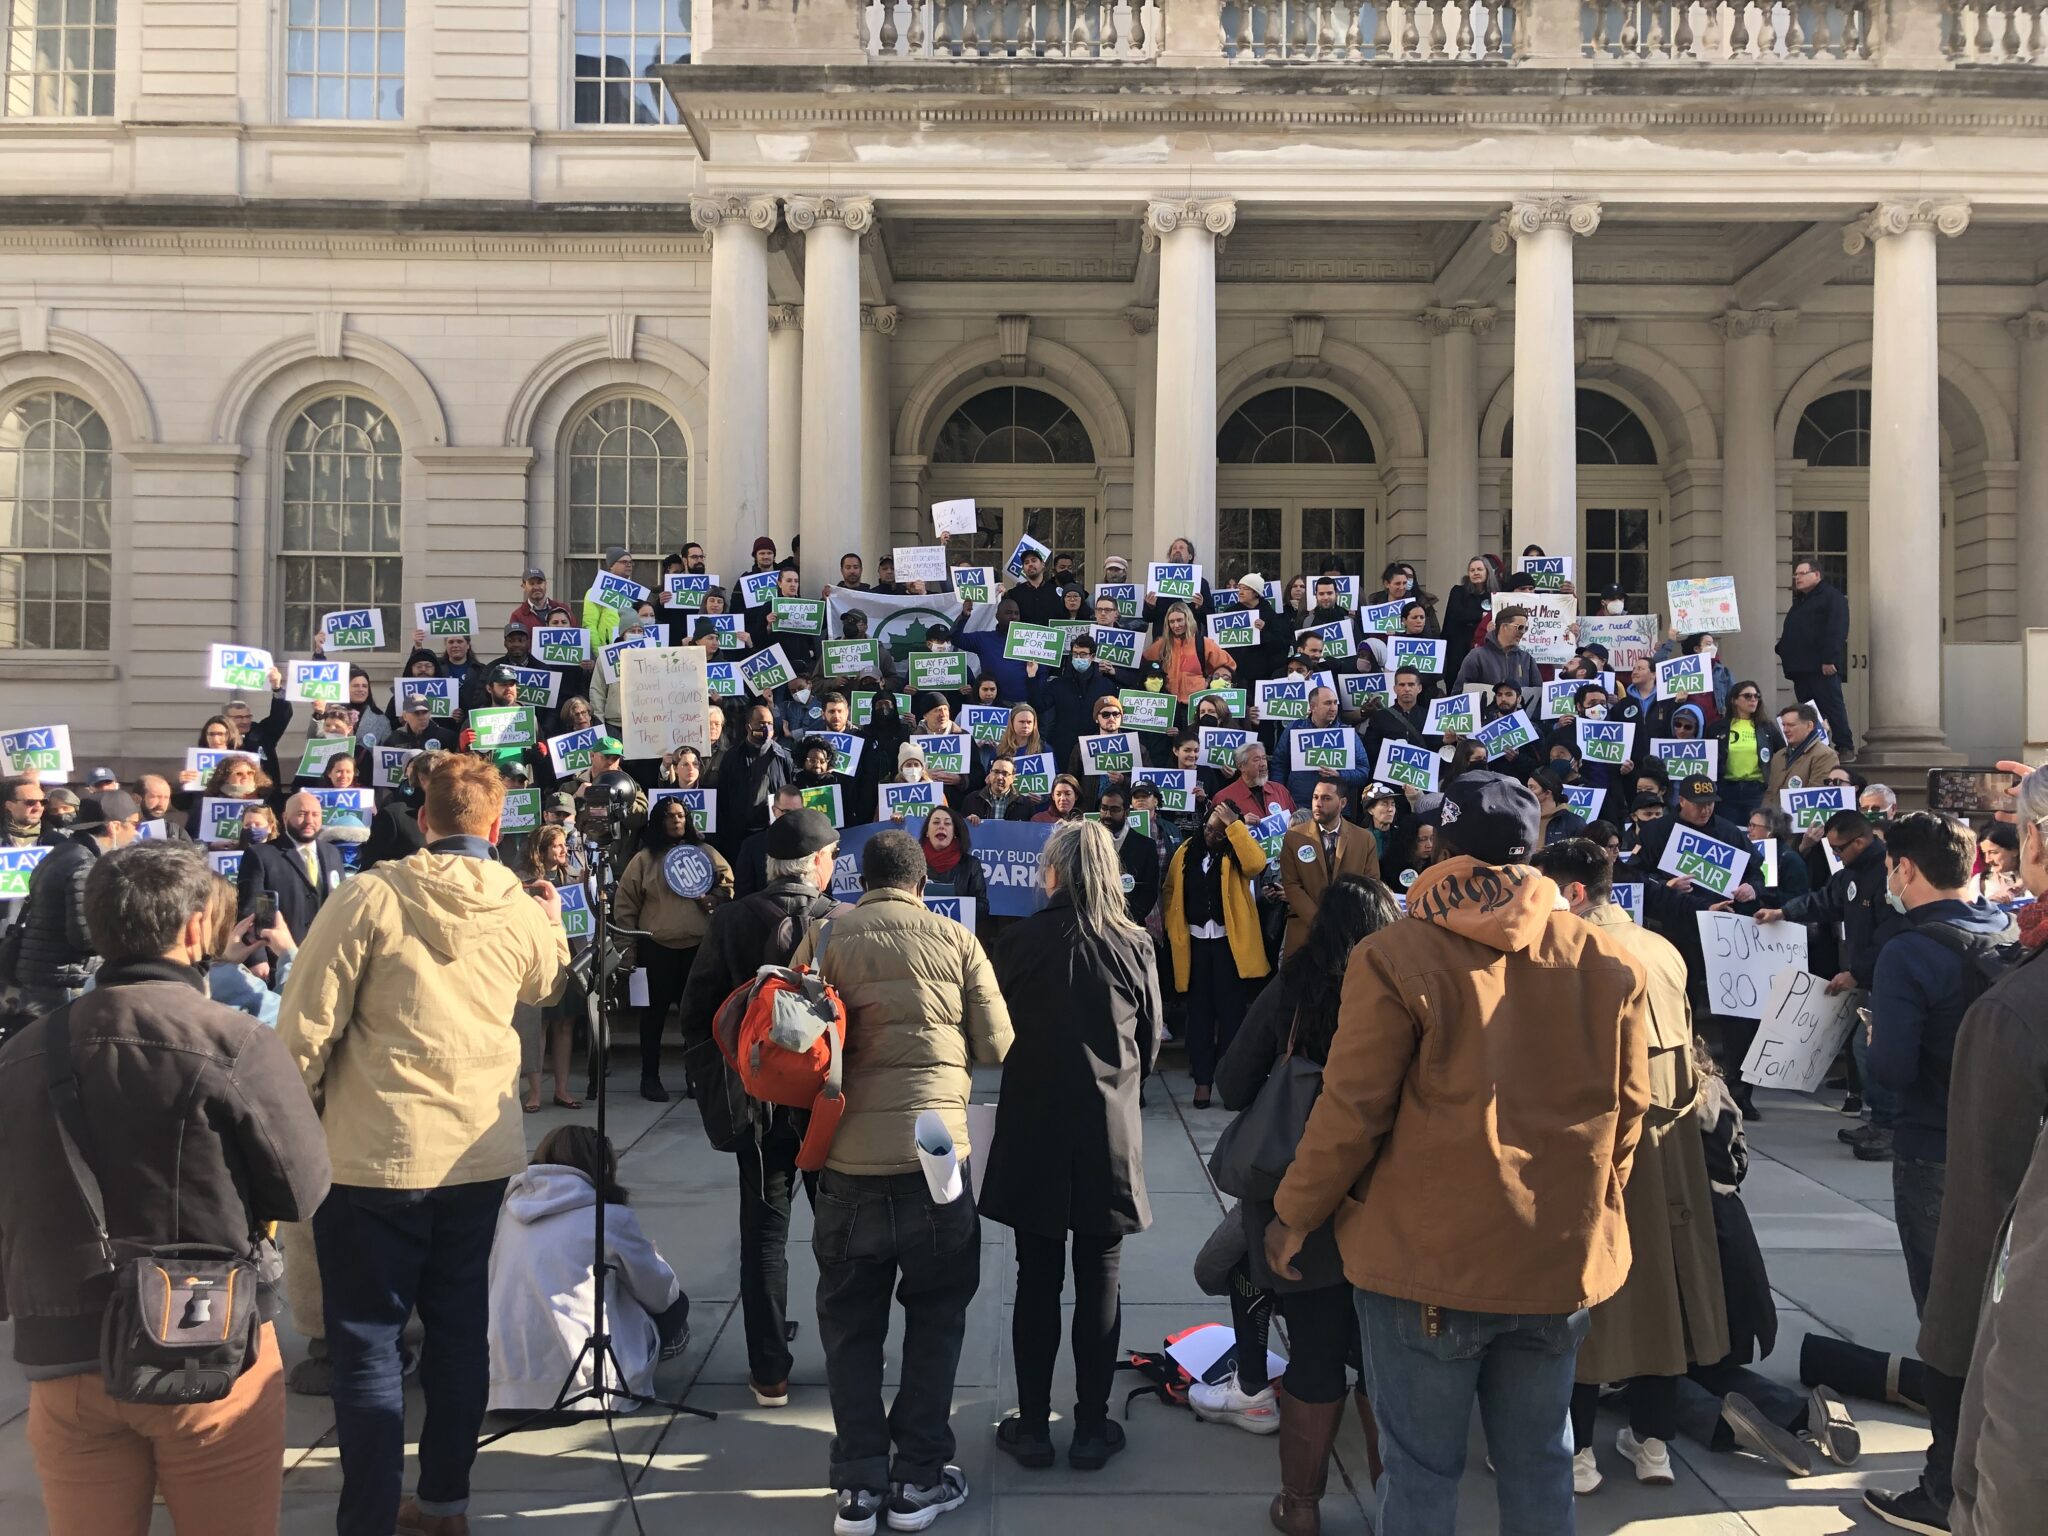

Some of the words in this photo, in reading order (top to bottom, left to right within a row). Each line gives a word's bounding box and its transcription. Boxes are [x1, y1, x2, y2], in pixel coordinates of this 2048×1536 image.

[1157, 567, 1191, 580] PLAY
[1526, 559, 1561, 573] PLAY
[674, 577, 707, 590] PLAY
[955, 571, 982, 586] PLAY
[603, 577, 639, 598] PLAY
[756, 588, 778, 601] FAI
[959, 586, 985, 600] FAIR
[1160, 580, 1190, 595] FAIR
[424, 602, 463, 621] PLAY
[1540, 605, 1561, 618] More
[327, 613, 367, 632] PLAY
[432, 620, 468, 634] FAIR
[715, 616, 732, 630] AY
[1215, 613, 1247, 631] PLAY
[1533, 618, 1562, 630] Spaces
[1591, 623, 1605, 631] we
[1608, 619, 1633, 630] need
[1676, 619, 1693, 632] ONE
[335, 631, 373, 644] FAIR
[541, 631, 578, 646] PLAY
[1014, 630, 1034, 639] PLAY
[1036, 632, 1056, 640] FAIR
[1097, 631, 1133, 646] PLAY
[1220, 630, 1251, 643] FAIR
[1322, 625, 1338, 641] AY
[1528, 635, 1551, 645] Being
[1024, 639, 1043, 648] FOR
[1397, 641, 1432, 655] PLAY
[1588, 636, 1613, 648] green
[1615, 634, 1648, 646] spaces
[545, 646, 580, 662] FAIR
[829, 647, 848, 656] PLAY
[851, 644, 869, 653] FAIR
[1099, 645, 1131, 664] FAIR
[1321, 642, 1345, 657] AIR
[742, 651, 771, 678] PLAY
[916, 659, 936, 667] PLAY
[938, 657, 958, 666] FAIR
[1400, 654, 1432, 670] FAIR
[1615, 650, 1626, 667] IN
[299, 665, 338, 681] PLAY
[710, 664, 729, 679] AY
[928, 667, 946, 675] FOR
[1663, 658, 1697, 680] PLAY
[226, 670, 262, 687] FAIR
[752, 669, 785, 689] FAIR
[1347, 676, 1382, 693] PLAY
[1668, 676, 1701, 692] FAIR
[303, 682, 337, 698] FAIR
[708, 680, 733, 693] AIR
[1264, 685, 1303, 700] PLAY
[432, 698, 447, 714] IR
[1124, 698, 1144, 706] PLAY
[1146, 699, 1166, 707] FAIR
[1268, 701, 1304, 716] FAIR
[1438, 698, 1467, 717] PLAY
[971, 711, 1008, 725] PLAY
[1134, 706, 1153, 716] FOR
[631, 713, 648, 726] We
[680, 712, 702, 723] save
[1439, 716, 1470, 731] FAIR
[637, 730, 660, 744] The
[1478, 717, 1513, 744] PLAY
[1584, 725, 1620, 741] PLAY
[3, 731, 49, 753] PLAY
[557, 732, 594, 756] PLAY
[830, 736, 849, 750] AY
[921, 738, 957, 753] PLAY
[1089, 737, 1124, 754] PLAY
[1206, 733, 1243, 748] PLAY
[1301, 731, 1341, 750] PLAY
[1489, 731, 1526, 754] FAIR
[1209, 749, 1234, 766] FAI
[1307, 750, 1344, 766] FAIR
[1390, 747, 1428, 767] PLAY
[1587, 741, 1620, 760] FAIR
[1661, 744, 1703, 758] PLAY
[12, 753, 58, 769] FAIR
[566, 752, 592, 770] FAI
[926, 757, 958, 771] FAIR
[1097, 754, 1131, 769] FAIR
[1391, 763, 1426, 787] FAIR
[888, 786, 928, 804] PLAY
[1693, 782, 1713, 794] 983
[1161, 791, 1182, 807] AIR
[1568, 791, 1591, 806] AY
[1792, 790, 1838, 810] PLAY
[214, 805, 244, 820] PLA
[894, 804, 930, 817] FAIR
[971, 848, 1004, 861] CITY
[1681, 835, 1732, 866] PLAY
[670, 854, 707, 888] 1505
[1679, 853, 1724, 888] FAIR
[0, 873, 27, 890] FA
[832, 876, 860, 891] AIR
[568, 914, 585, 931] IR
[1713, 916, 1750, 960] 50
[1752, 924, 1809, 964] Rangers
[1719, 972, 1757, 1009] 80
